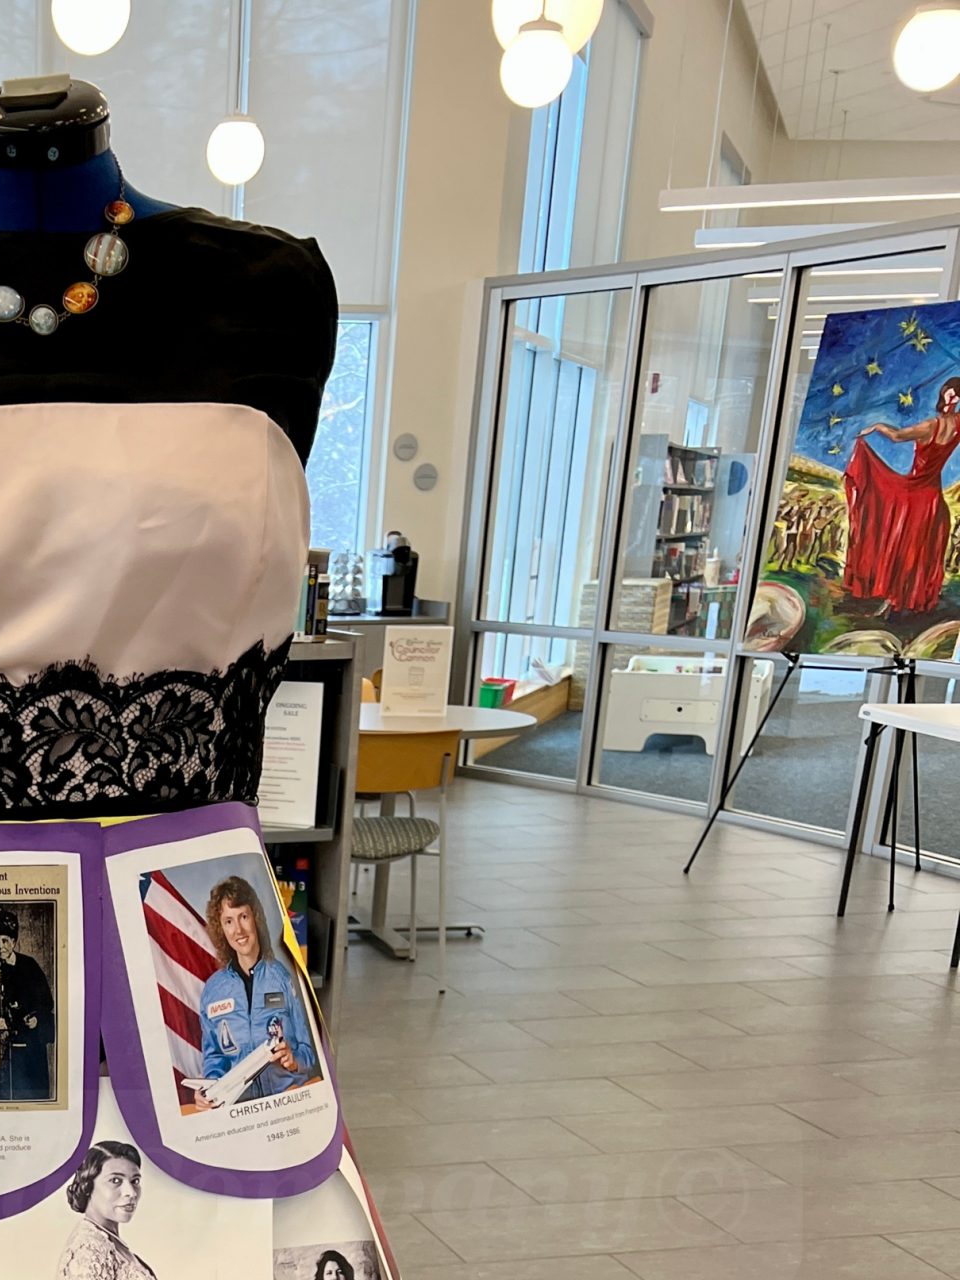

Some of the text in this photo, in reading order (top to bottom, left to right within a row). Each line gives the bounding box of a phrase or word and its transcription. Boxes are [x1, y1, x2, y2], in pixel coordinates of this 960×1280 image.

[15, 884, 60, 895] Inventions
[211, 1002, 231, 1014] NASA
[229, 1102, 272, 1119] CHRISTA
[195, 1129, 225, 1143] American
[257, 1121, 268, 1129] and
